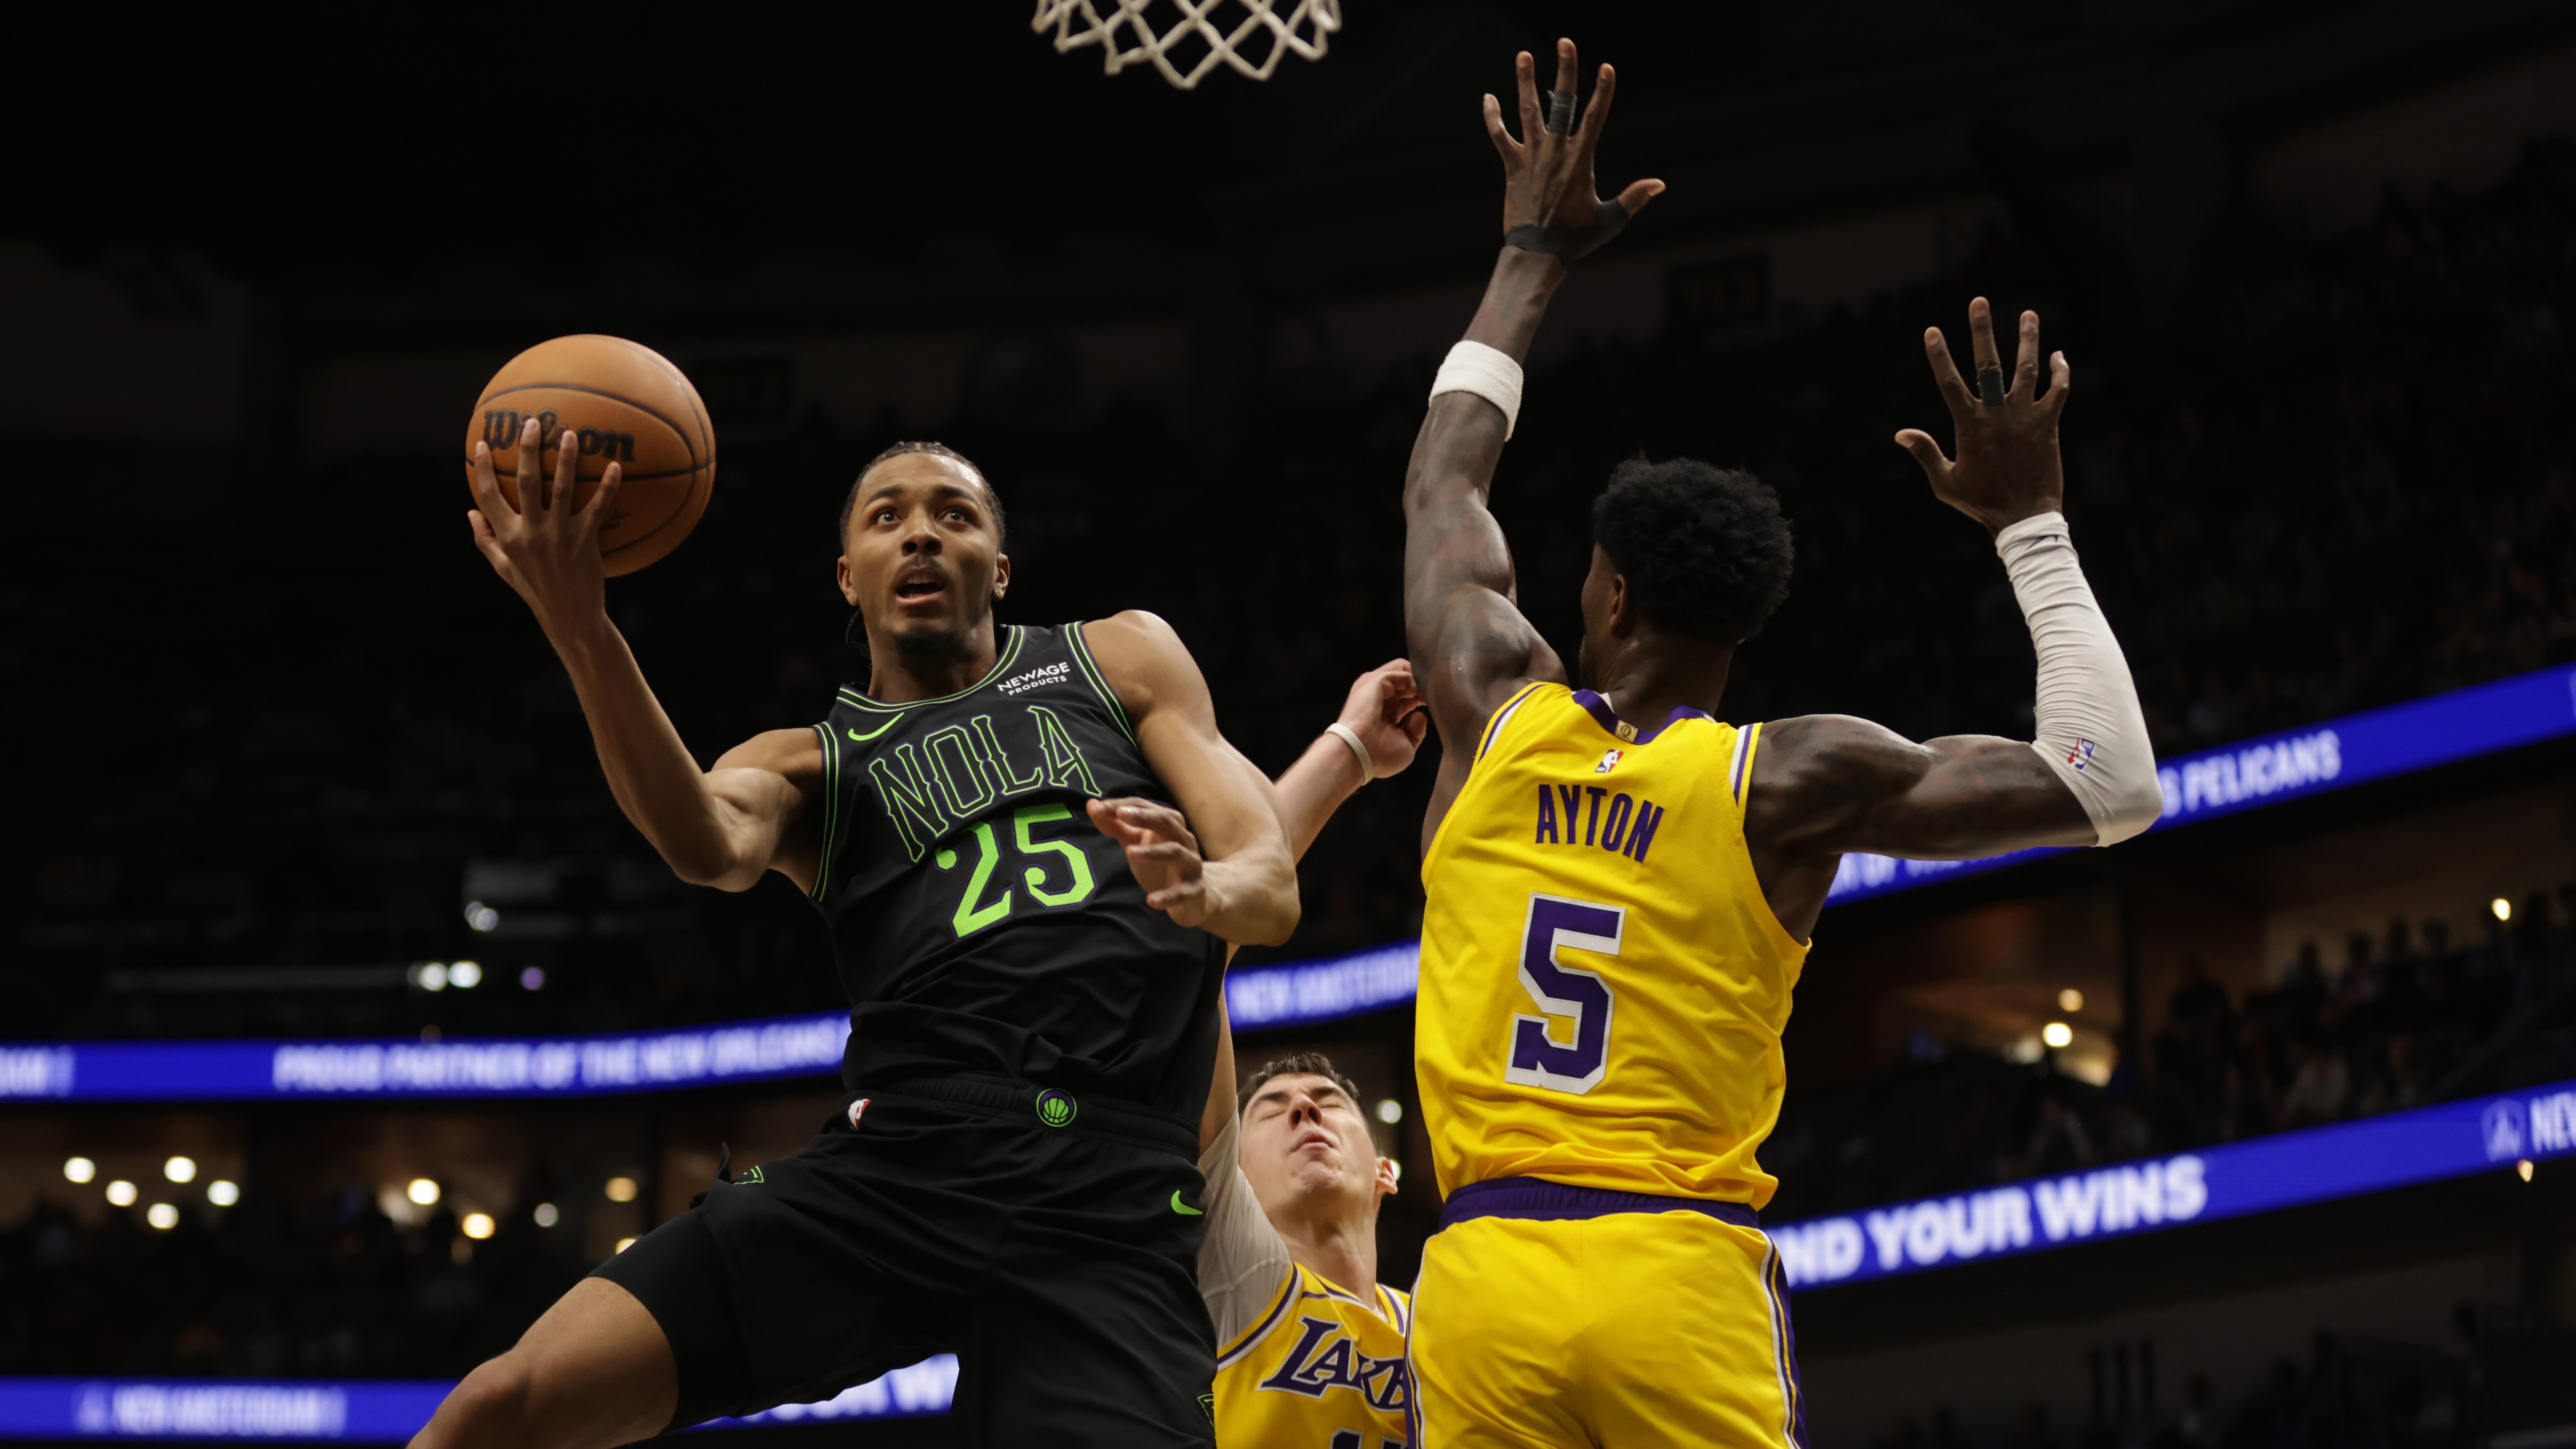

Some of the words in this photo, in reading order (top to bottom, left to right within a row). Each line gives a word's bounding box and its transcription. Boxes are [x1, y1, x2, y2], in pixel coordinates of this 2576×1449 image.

[997, 661, 1070, 691] NEWAGE
[1008, 675, 1067, 696] PRODUCTS
[869, 705, 1103, 863] NOLA
[1535, 784, 1665, 863] AYTON
[2182, 729, 2342, 812] PELICANS
[934, 802, 1099, 940] 25
[1504, 892, 1626, 1095] 5
[1767, 1216, 1865, 1288] ND
[1866, 1186, 2032, 1271] YOUR
[2033, 1155, 2208, 1241] WINS
